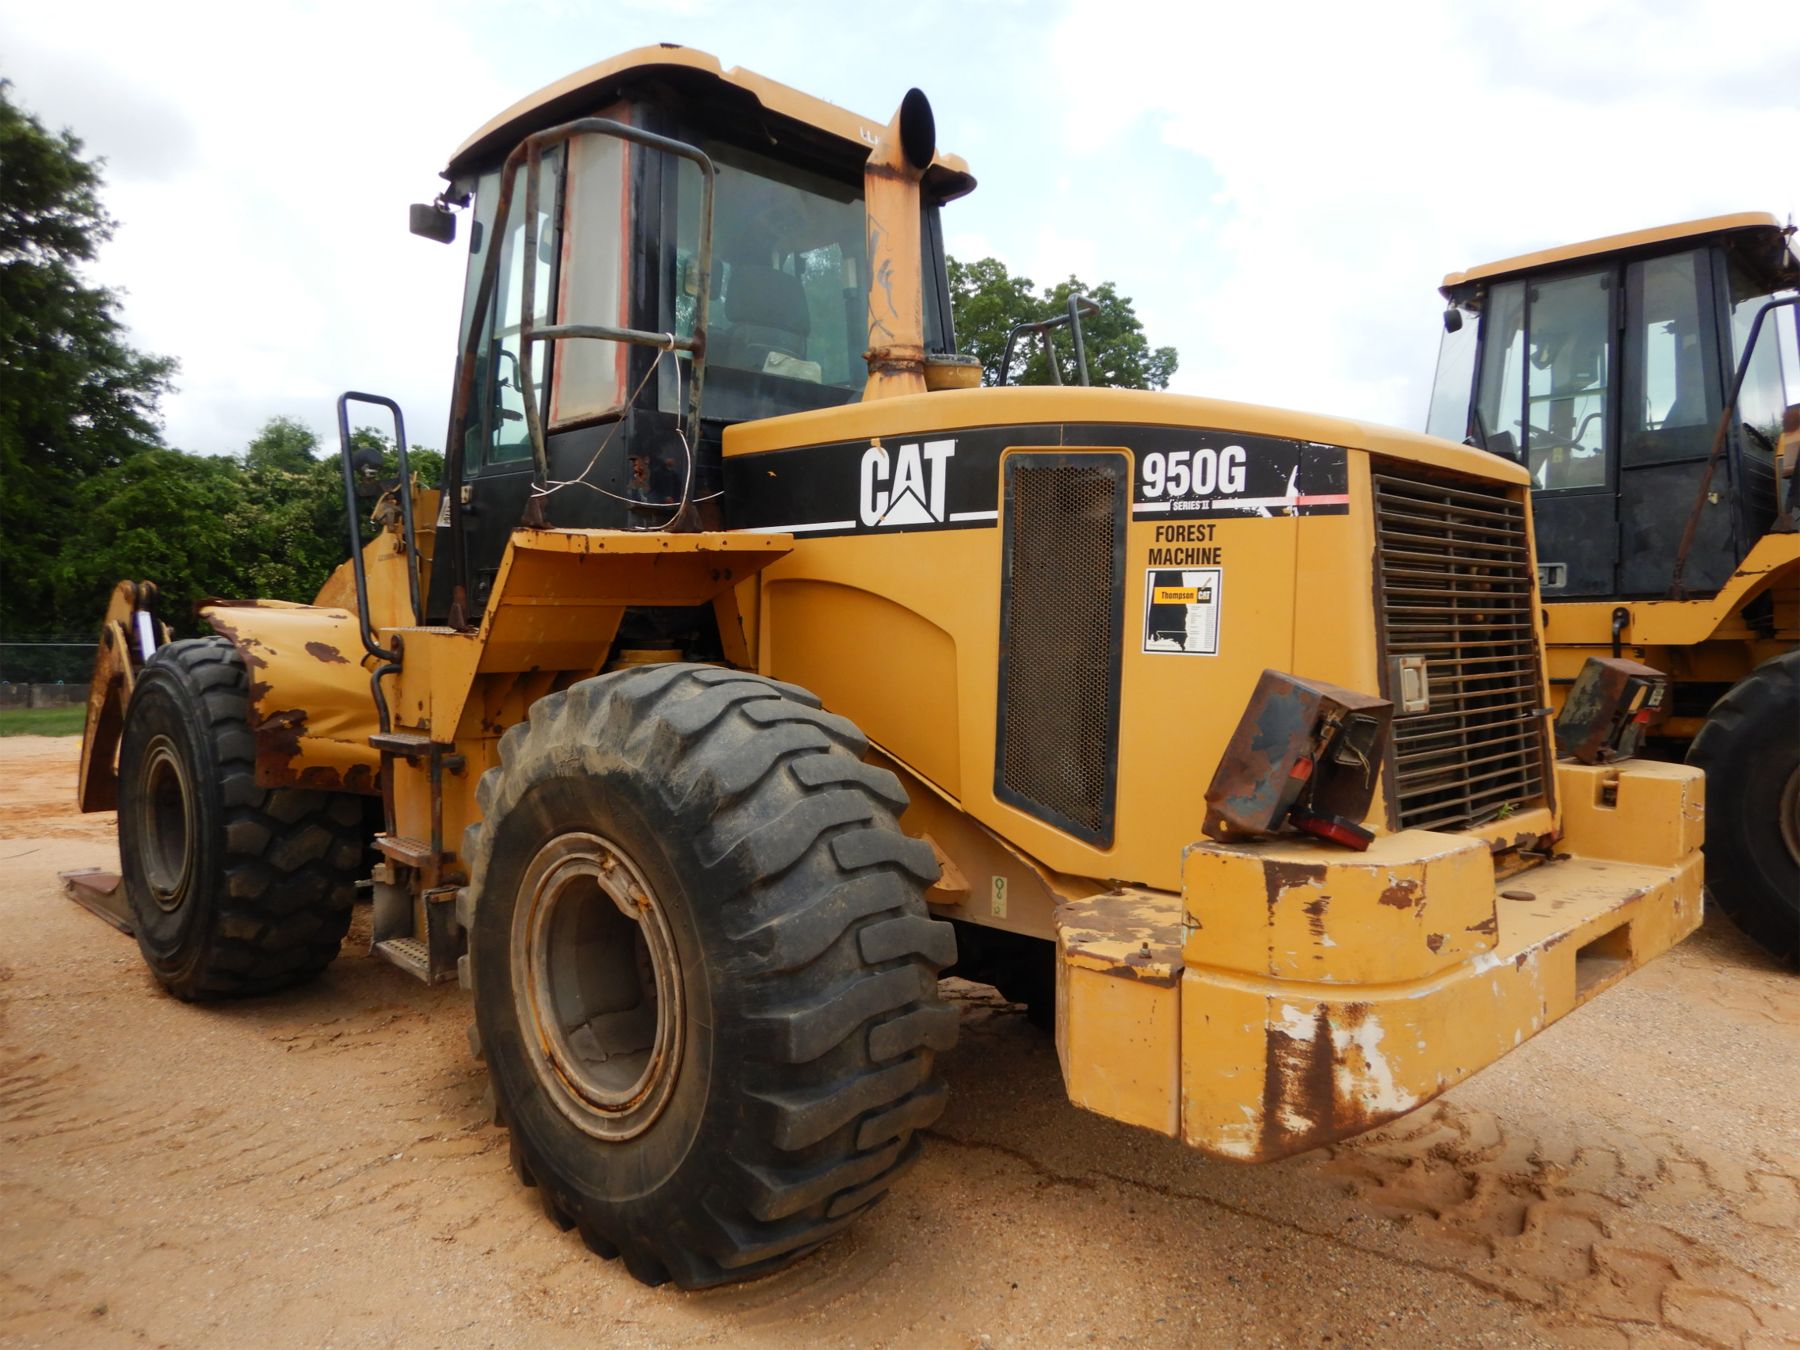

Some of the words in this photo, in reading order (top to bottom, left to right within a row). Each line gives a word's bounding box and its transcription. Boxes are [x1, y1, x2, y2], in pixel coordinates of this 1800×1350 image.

[1142, 445, 1246, 497] 950G
[860, 439, 956, 527] CAT
[1172, 501, 1201, 511] SERIES
[1202, 500, 1210, 510] II
[1155, 524, 1216, 543] FOREST
[1148, 547, 1222, 566] MACHINE
[1161, 591, 1194, 600] Thompson
